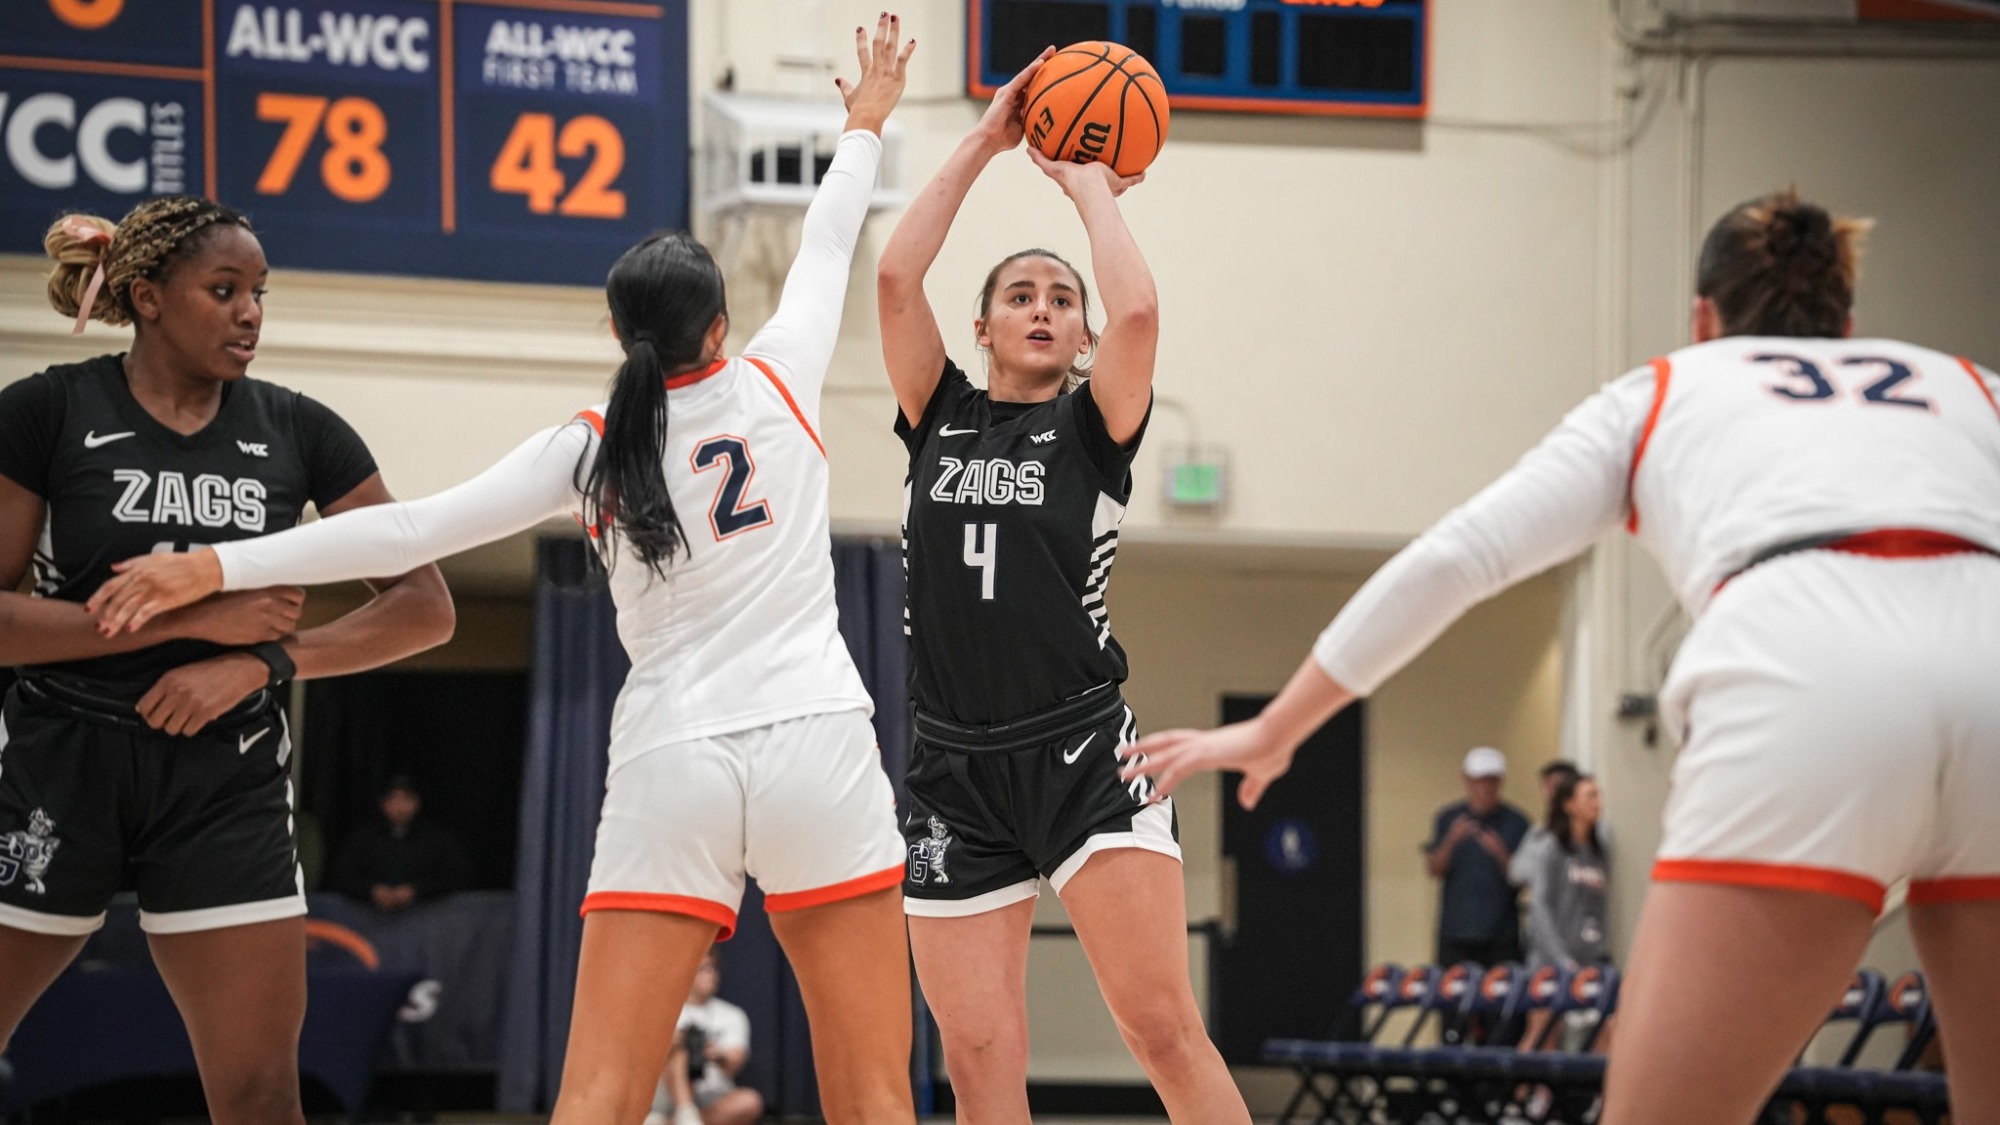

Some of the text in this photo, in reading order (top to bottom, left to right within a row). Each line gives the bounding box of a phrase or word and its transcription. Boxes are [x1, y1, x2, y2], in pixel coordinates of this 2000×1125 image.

[226, 4, 429, 73] ALL-WCC
[484, 19, 636, 67] ALL-WCC
[482, 56, 638, 95] FIRST TEAM
[0, 91, 147, 194] CC
[255, 93, 392, 202] 78
[490, 112, 627, 218] 42
[1743, 351, 1941, 416] 32
[1029, 429, 1058, 445] WCC
[112, 468, 267, 532] ZAGS
[689, 433, 774, 542] 2
[930, 456, 1046, 506] ZAGS
[962, 522, 998, 601] 4
